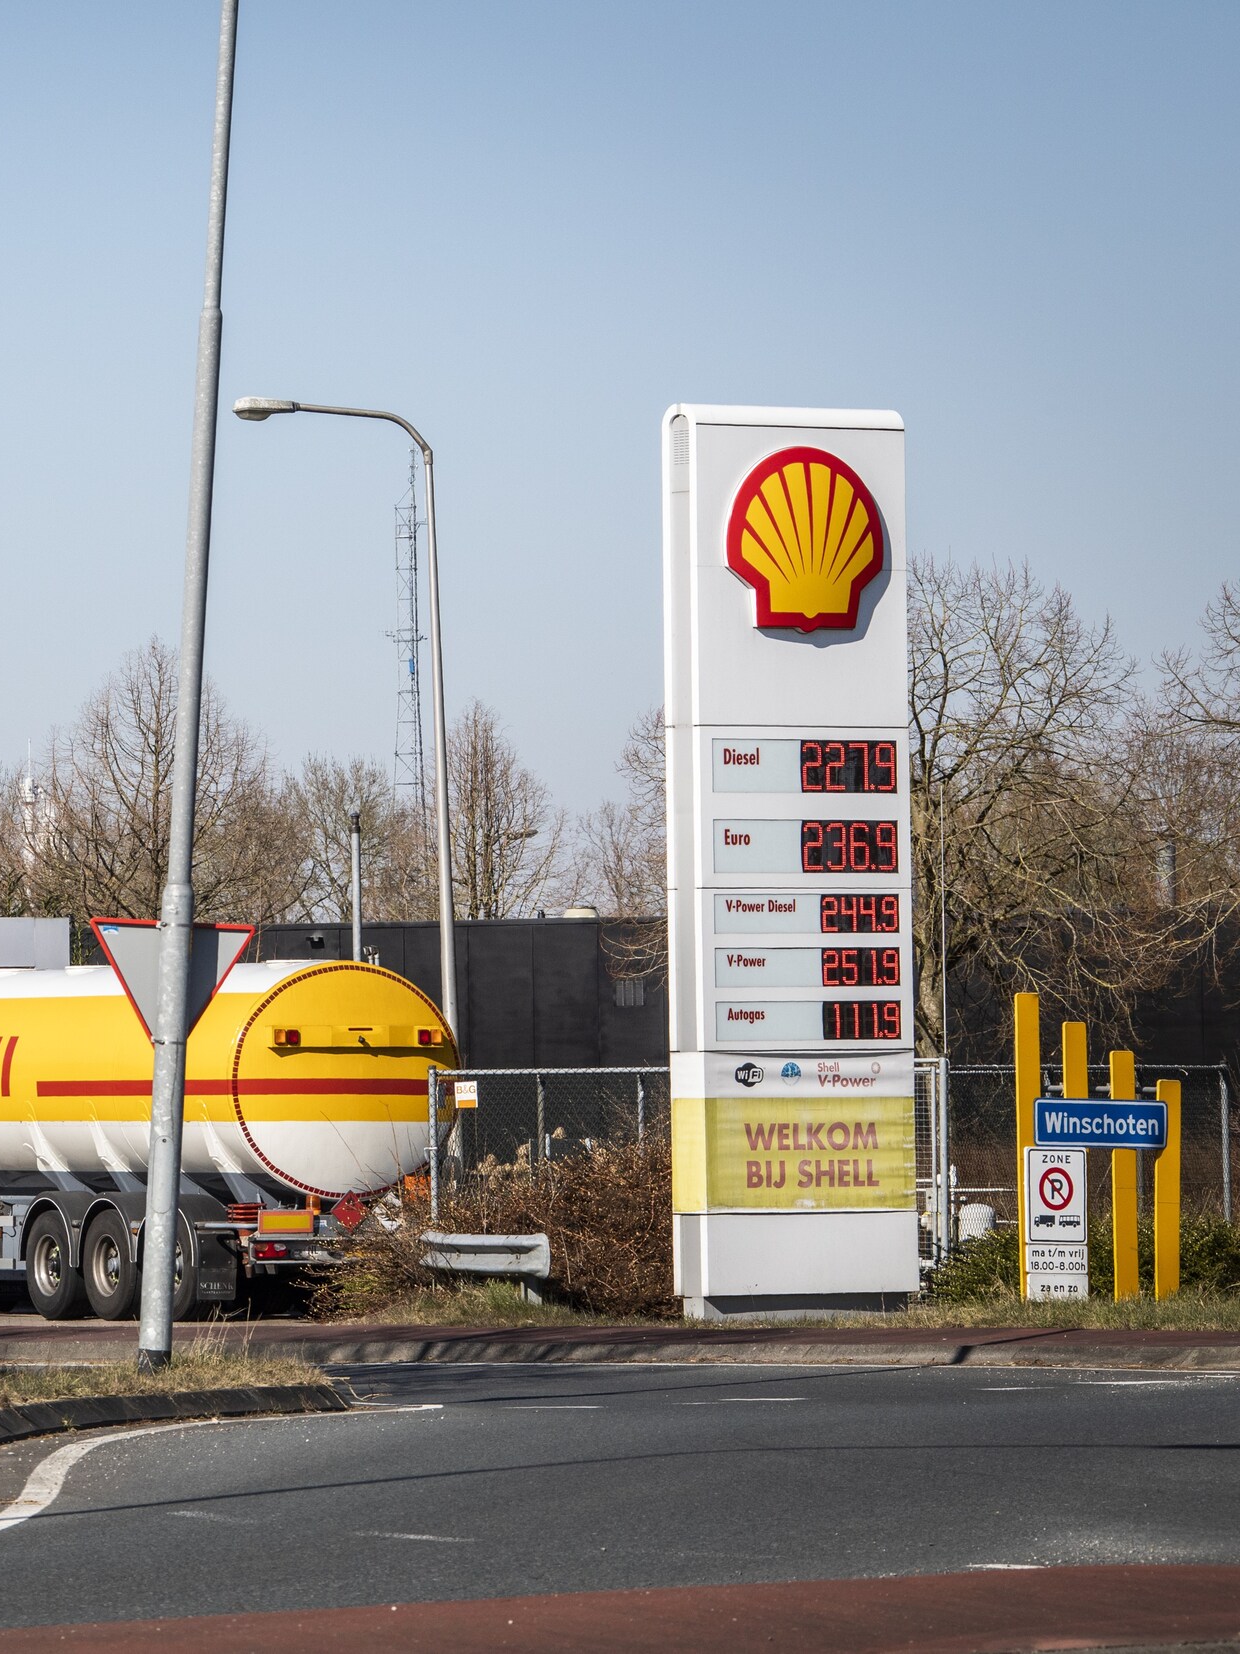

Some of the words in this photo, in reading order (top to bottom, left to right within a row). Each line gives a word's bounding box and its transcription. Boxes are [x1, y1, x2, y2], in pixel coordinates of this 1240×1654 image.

[723, 747, 760, 766] Diesel
[724, 828, 751, 846] Euro
[725, 899, 765, 914] V-Power
[768, 898, 796, 914] Diesel
[726, 954, 766, 968] V-Power
[727, 1008, 765, 1025] Autogas
[817, 1061, 840, 1073] Shell
[817, 1074, 877, 1088] V-Power
[456, 1085, 476, 1095] B&G
[1044, 1111, 1159, 1136] Winschoten
[744, 1121, 879, 1151] WELKOM
[1042, 1154, 1071, 1164] ZONE
[746, 1160, 786, 1188] BIJ
[797, 1159, 880, 1188] SHELL
[1032, 1249, 1045, 1258] ma
[1048, 1247, 1066, 1258] t/m
[1069, 1249, 1085, 1260] vrij
[1030, 1261, 1086, 1272] 18.00-8.00h
[1040, 1284, 1051, 1293] za
[1054, 1284, 1065, 1293] en
[1067, 1284, 1078, 1293] zo
